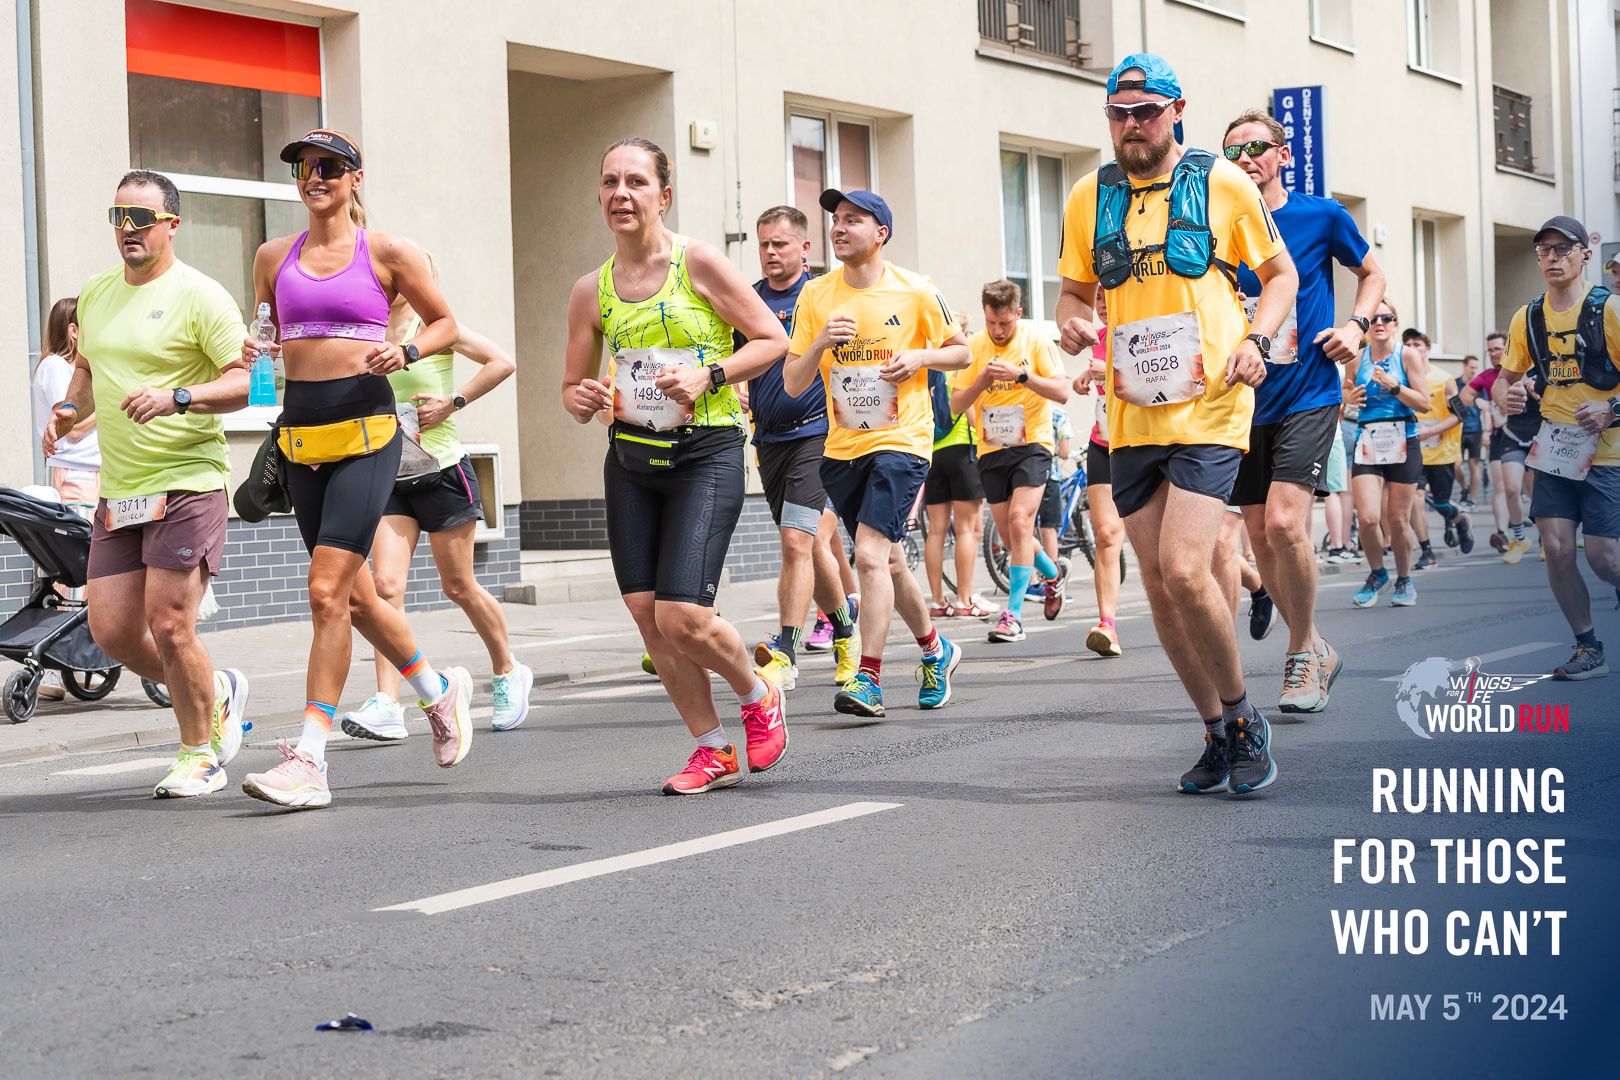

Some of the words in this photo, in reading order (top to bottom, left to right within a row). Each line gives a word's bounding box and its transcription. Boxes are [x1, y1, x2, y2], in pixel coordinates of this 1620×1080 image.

[1131, 260, 1165, 277] ORLD
[840, 350, 873, 362] WORLD
[873, 349, 893, 360] RUN
[1134, 355, 1179, 375] 10528
[633, 387, 668, 401] 1499
[636, 404, 664, 412] Katarzyna
[847, 396, 881, 407] 12206
[685, 413, 693, 423] 2
[891, 414, 897, 423] 2
[1550, 446, 1580, 459] 14960
